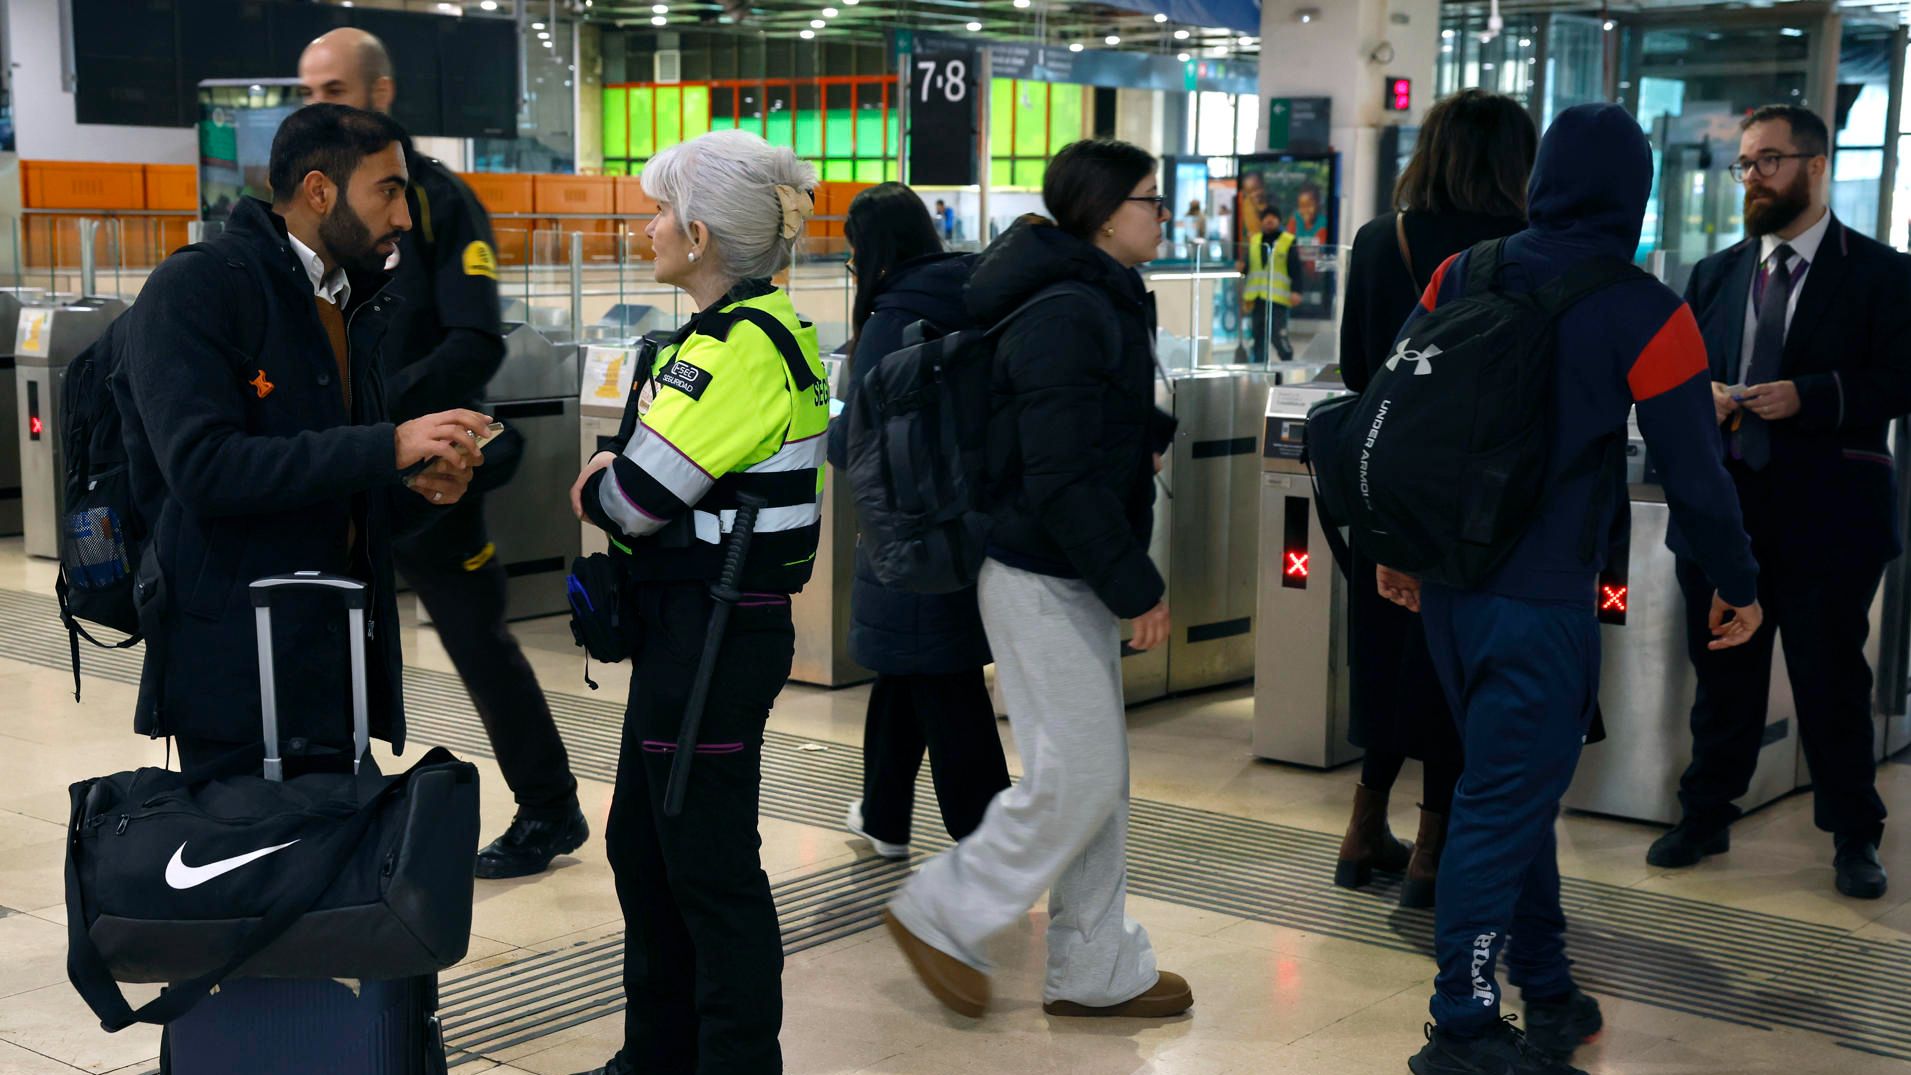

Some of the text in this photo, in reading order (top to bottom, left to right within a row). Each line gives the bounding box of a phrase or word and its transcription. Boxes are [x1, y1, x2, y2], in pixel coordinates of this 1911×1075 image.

[662, 373, 694, 393] SEGURIDAD
[1359, 399, 1392, 511] UNDER ARMO
